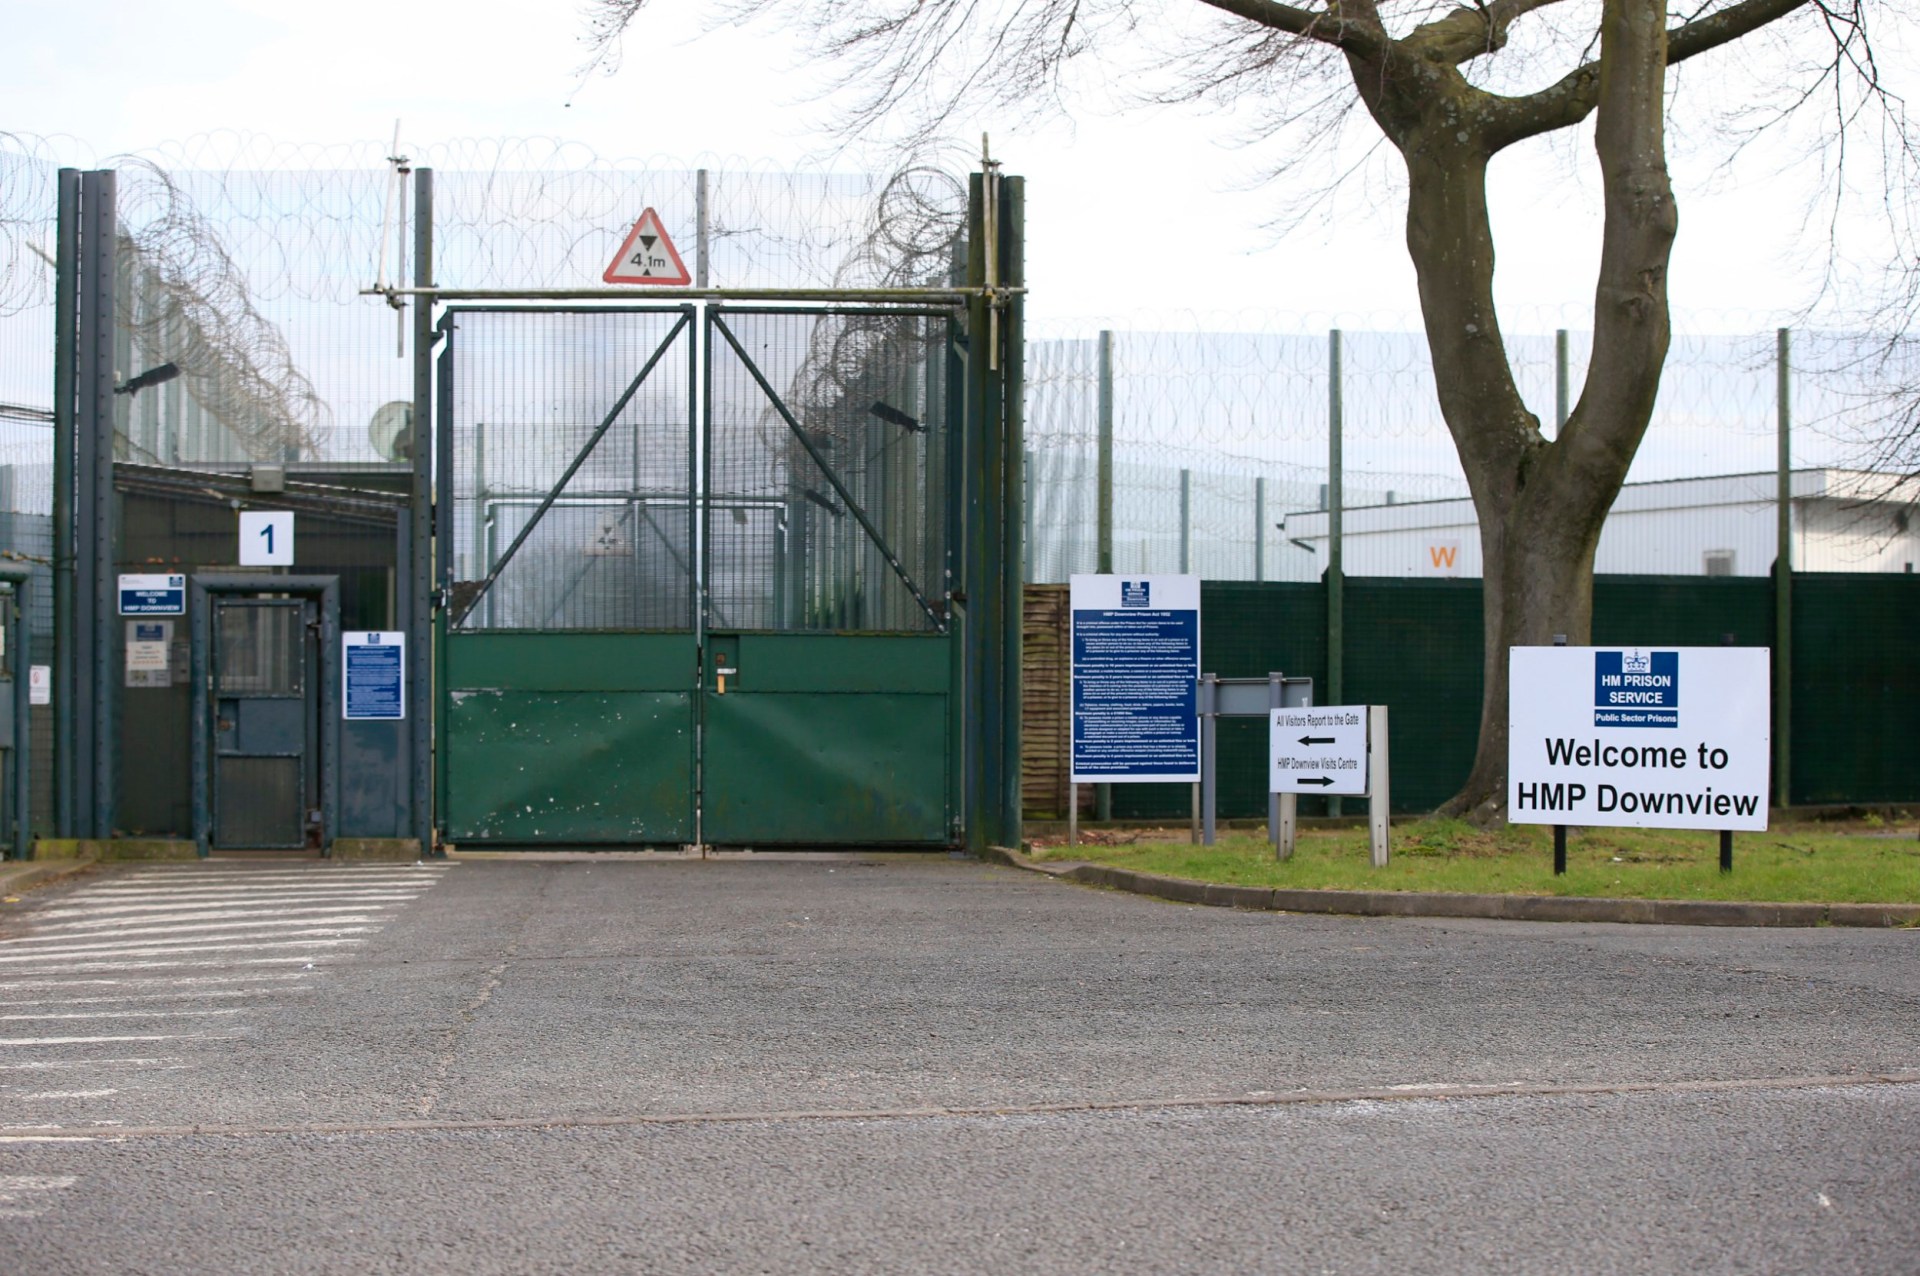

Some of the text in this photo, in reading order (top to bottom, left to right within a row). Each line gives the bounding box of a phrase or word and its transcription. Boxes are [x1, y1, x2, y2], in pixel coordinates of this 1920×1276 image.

[631, 253, 666, 267] 4.1m
[259, 524, 274, 554] 1
[1430, 546, 1456, 568] W
[1602, 675, 1671, 687] HM PRISON
[1609, 692, 1663, 704] SERVICE
[1285, 715, 1306, 727] Visitors
[1307, 714, 1327, 728] Report
[1327, 715, 1333, 726] to
[1334, 714, 1344, 726] the
[1345, 713, 1359, 725] Gate
[1595, 713, 1677, 723] Public Sector Prisons
[1545, 738, 1729, 770] Welcome to
[1277, 757, 1358, 769] HMP Downview Visits Centre
[1518, 782, 1759, 816] HMP Downview
